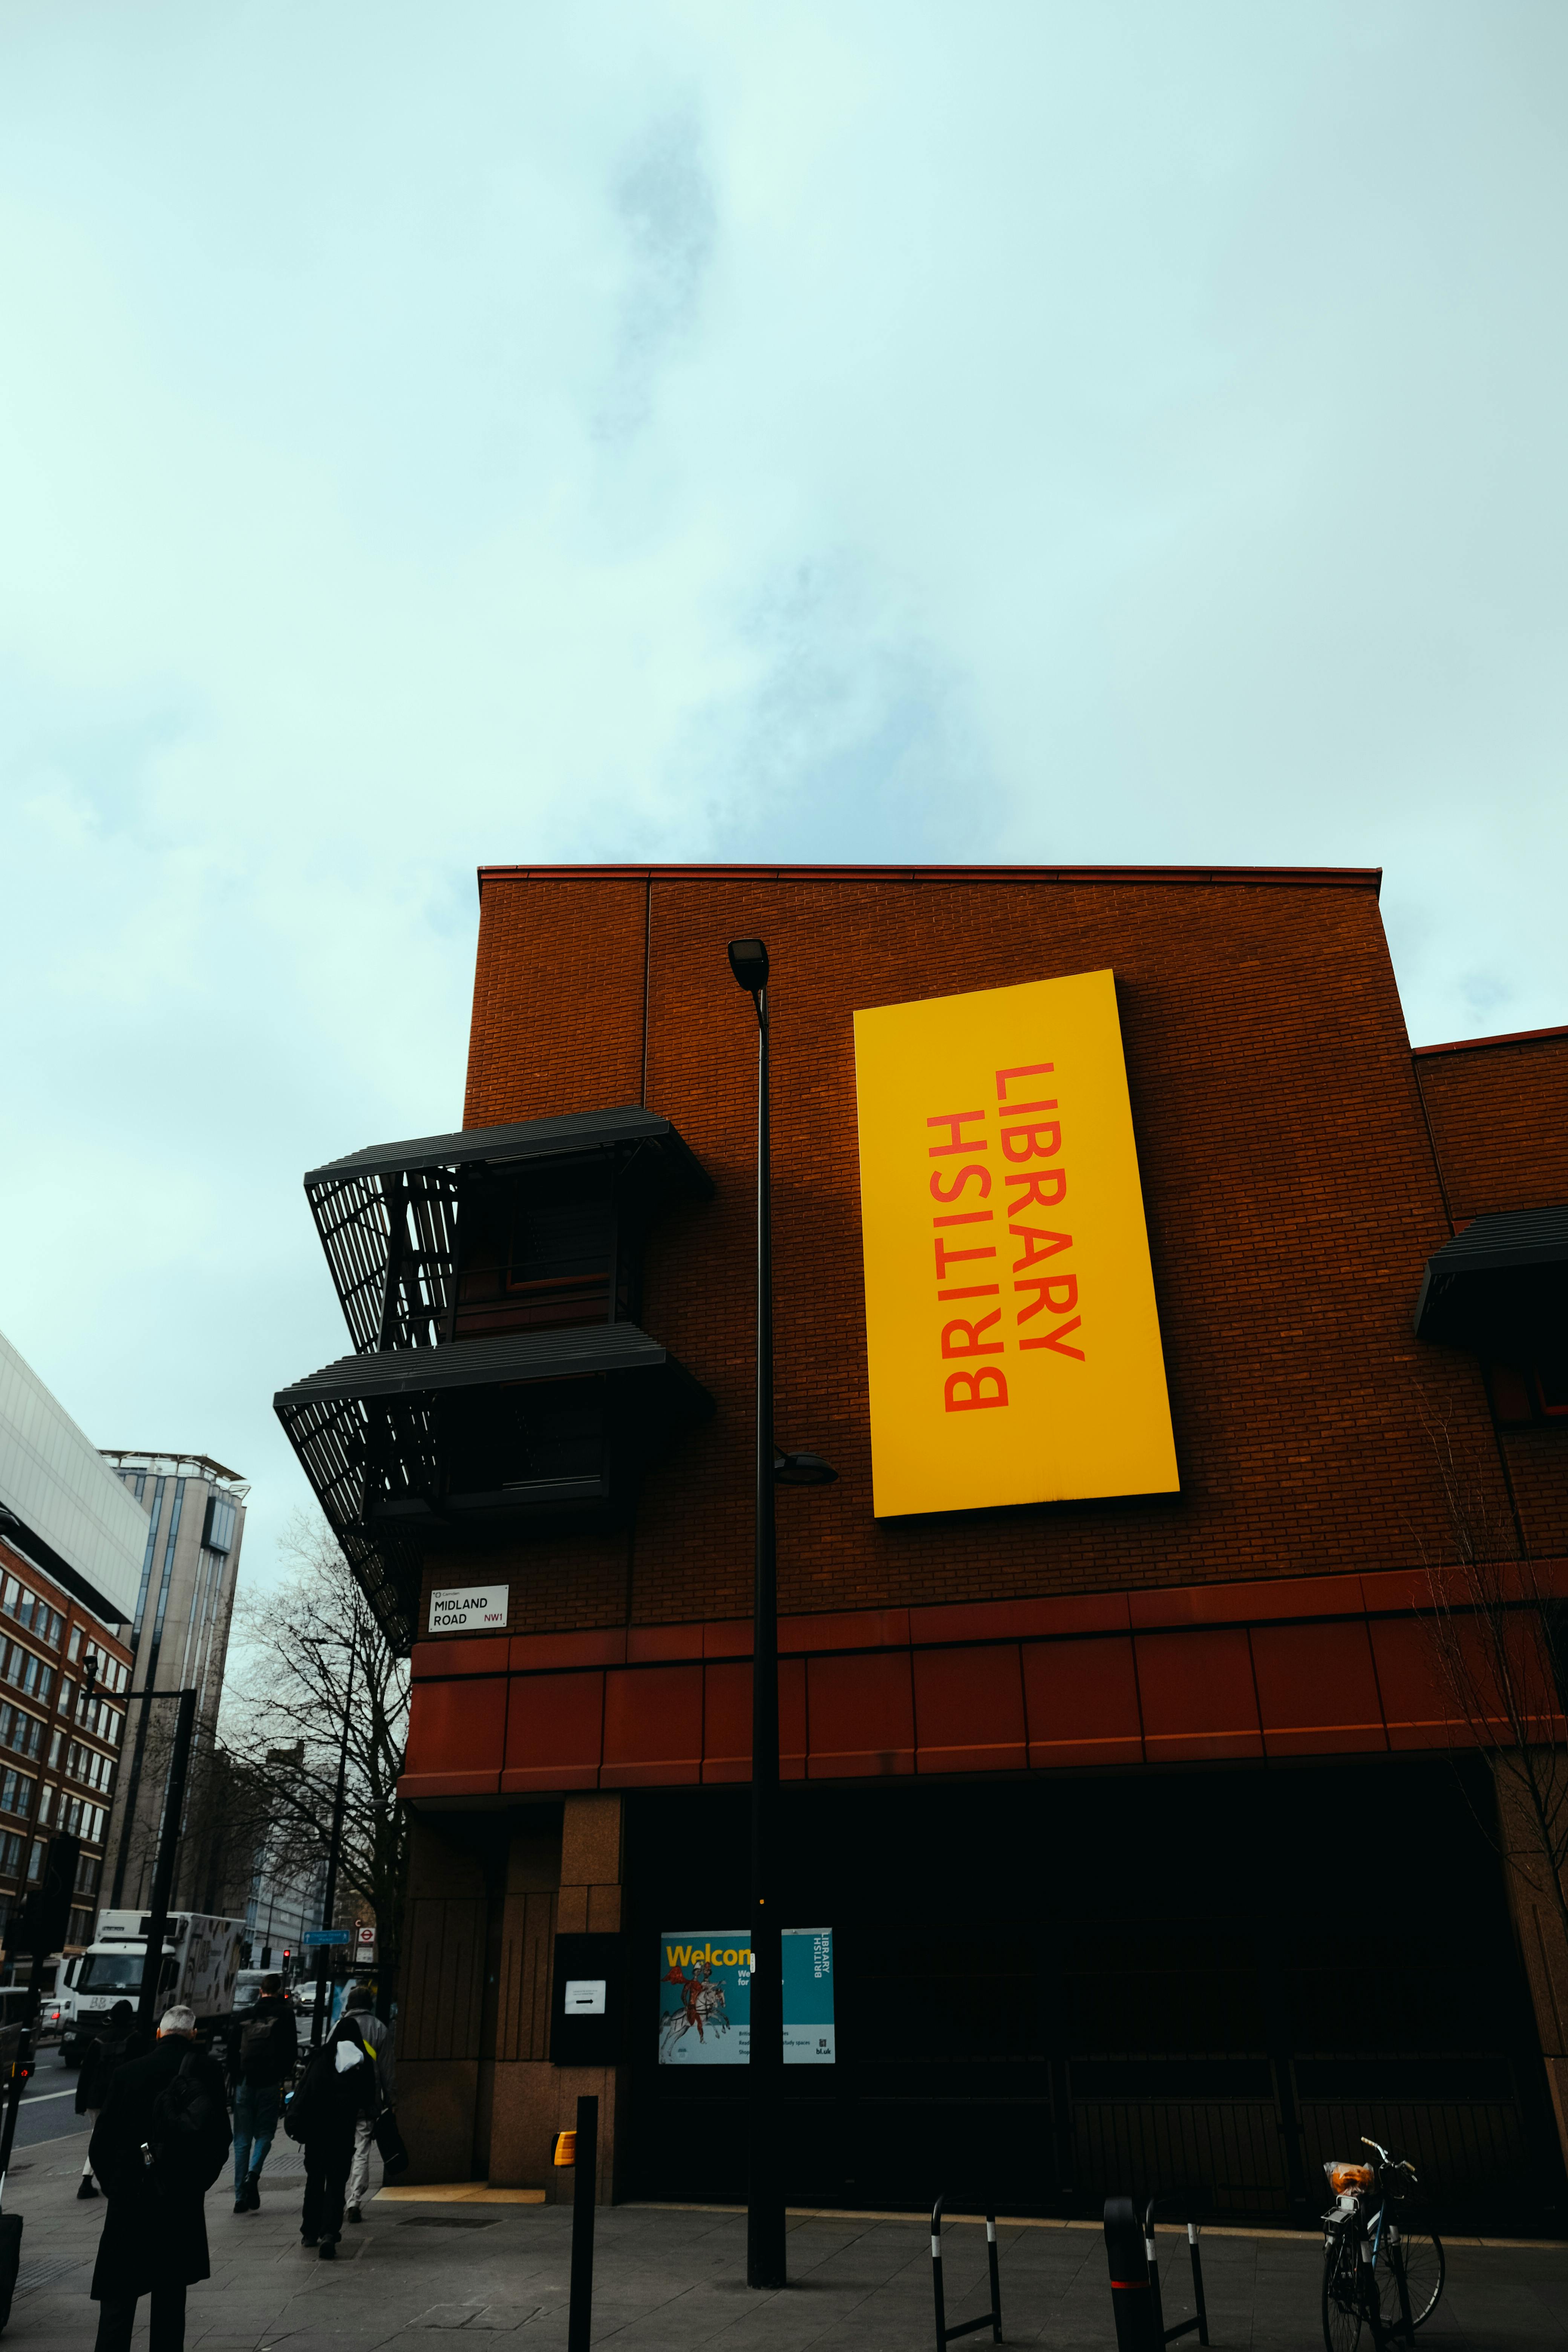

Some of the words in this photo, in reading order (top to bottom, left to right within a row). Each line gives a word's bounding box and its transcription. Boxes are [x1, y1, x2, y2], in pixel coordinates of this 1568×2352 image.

[996, 1063, 1085, 1361] LIBRARY
[927, 1110, 1009, 1412] BRITISH
[434, 1614, 467, 1626] ROAD
[484, 1613, 502, 1622] NW1
[435, 1598, 488, 1611] MIDLAND
[813, 1937, 822, 1978] BRITISH
[821, 1932, 830, 1973] LIBRARY
[738, 1978, 749, 1986] for
